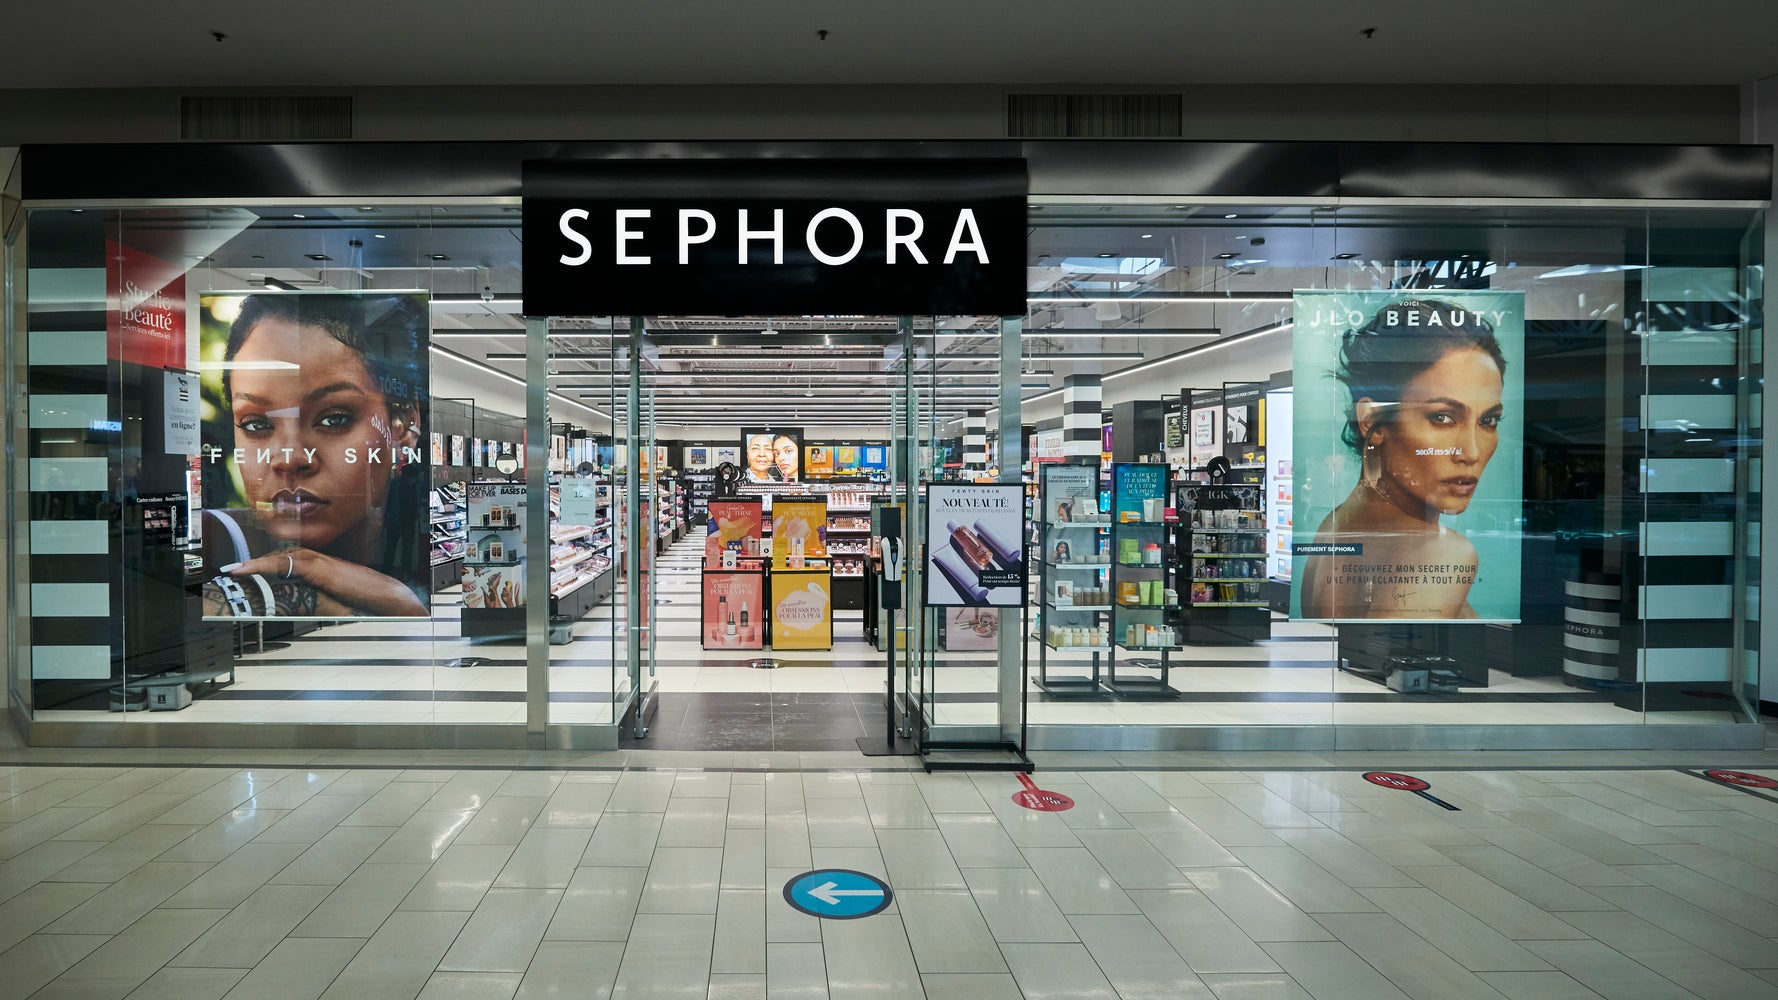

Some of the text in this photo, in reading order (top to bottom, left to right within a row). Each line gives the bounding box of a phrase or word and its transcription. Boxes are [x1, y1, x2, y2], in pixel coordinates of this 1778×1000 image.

[559, 207, 990, 266] SEPHORA
[125, 280, 171, 311] Studio
[125, 304, 172, 331] Beauté
[1310, 310, 1506, 327] JLO BEAUTY
[179, 422, 196, 431] ligne?
[344, 447, 422, 464] SKIN
[1208, 490, 1229, 499] IGK
[942, 497, 1009, 508] NOUVEAUTÉ!
[1342, 563, 1393, 573] DÉCOUVREZ
[1396, 564, 1415, 573] MON
[1418, 564, 1450, 573] SECRET
[1453, 564, 1477, 573] POUR
[1326, 576, 1344, 584] UNE
[1346, 576, 1369, 584] PEAU
[1372, 574, 1420, 584] ÉCLATANTE
[1422, 574, 1428, 584] À
[1431, 576, 1453, 584] TOUT
[1455, 574, 1475, 585] ÂGE.
